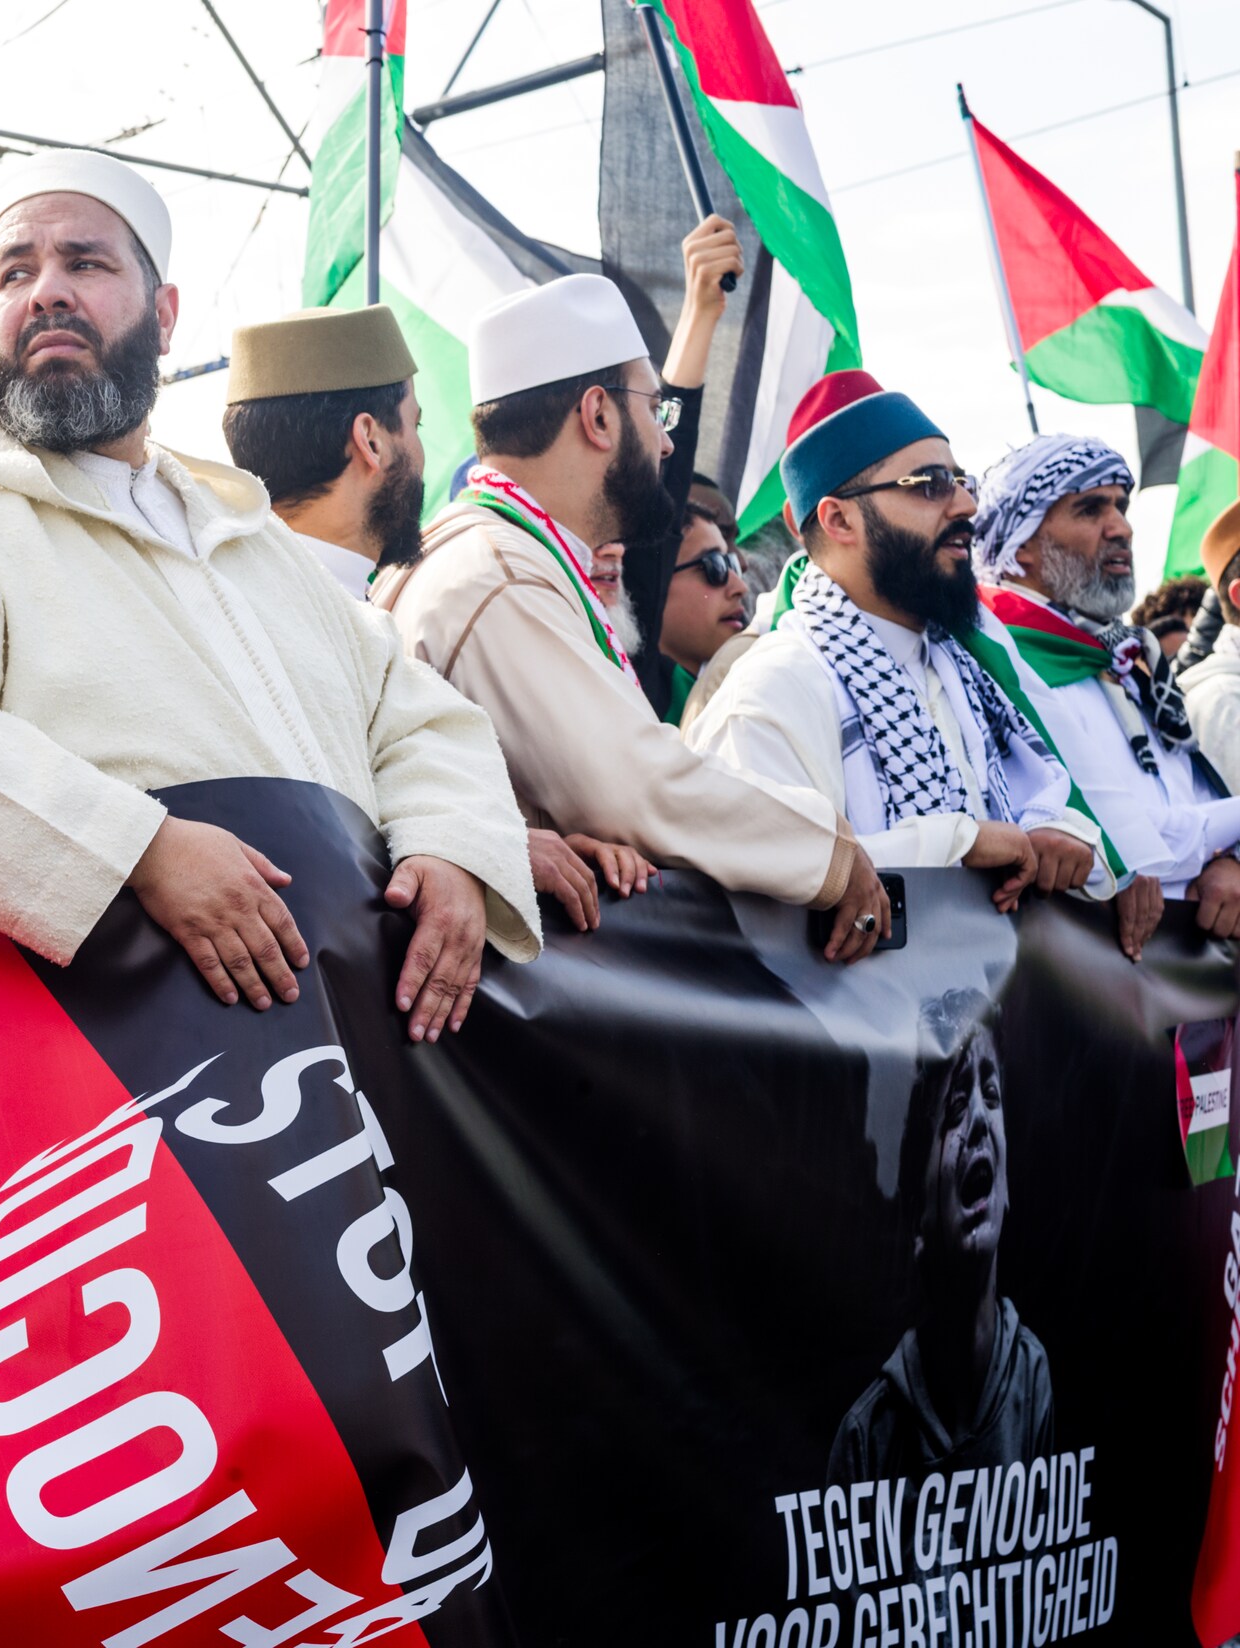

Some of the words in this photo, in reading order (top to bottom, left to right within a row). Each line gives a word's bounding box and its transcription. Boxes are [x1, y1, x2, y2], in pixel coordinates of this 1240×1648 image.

[1194, 1087, 1228, 1118] PALESTINE
[774, 1477, 907, 1601] TEGEN
[914, 1445, 1095, 1571] GENOCIDE
[852, 1536, 1118, 1648] GERECHTIGHEID
